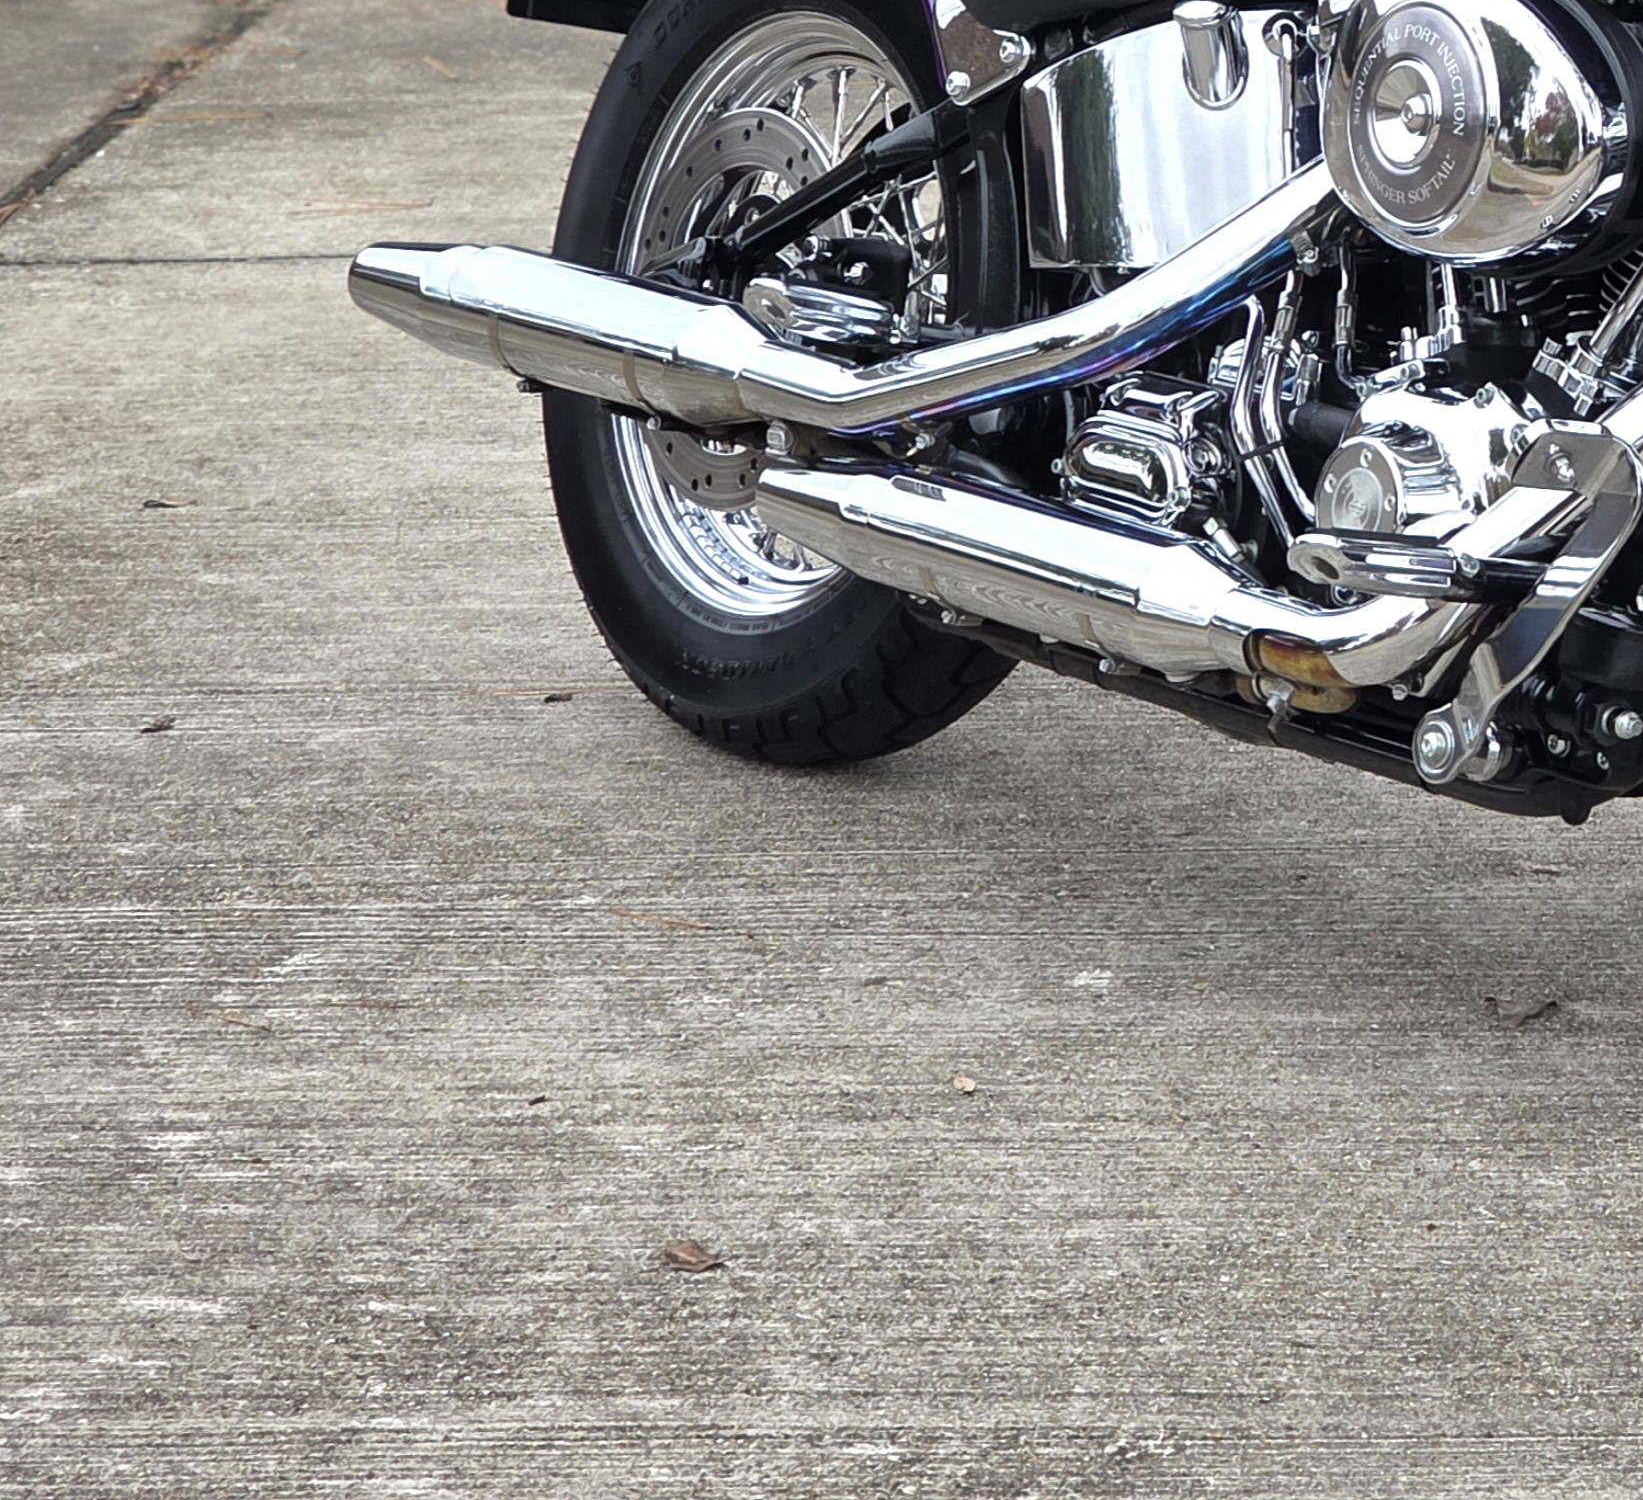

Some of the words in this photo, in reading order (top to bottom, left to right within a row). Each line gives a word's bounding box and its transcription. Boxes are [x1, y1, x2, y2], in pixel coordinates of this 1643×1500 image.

[1353, 27, 1402, 126] SEQUENTIAL
[1403, 23, 1441, 47] PORT
[1436, 41, 1467, 137] INJECTION
